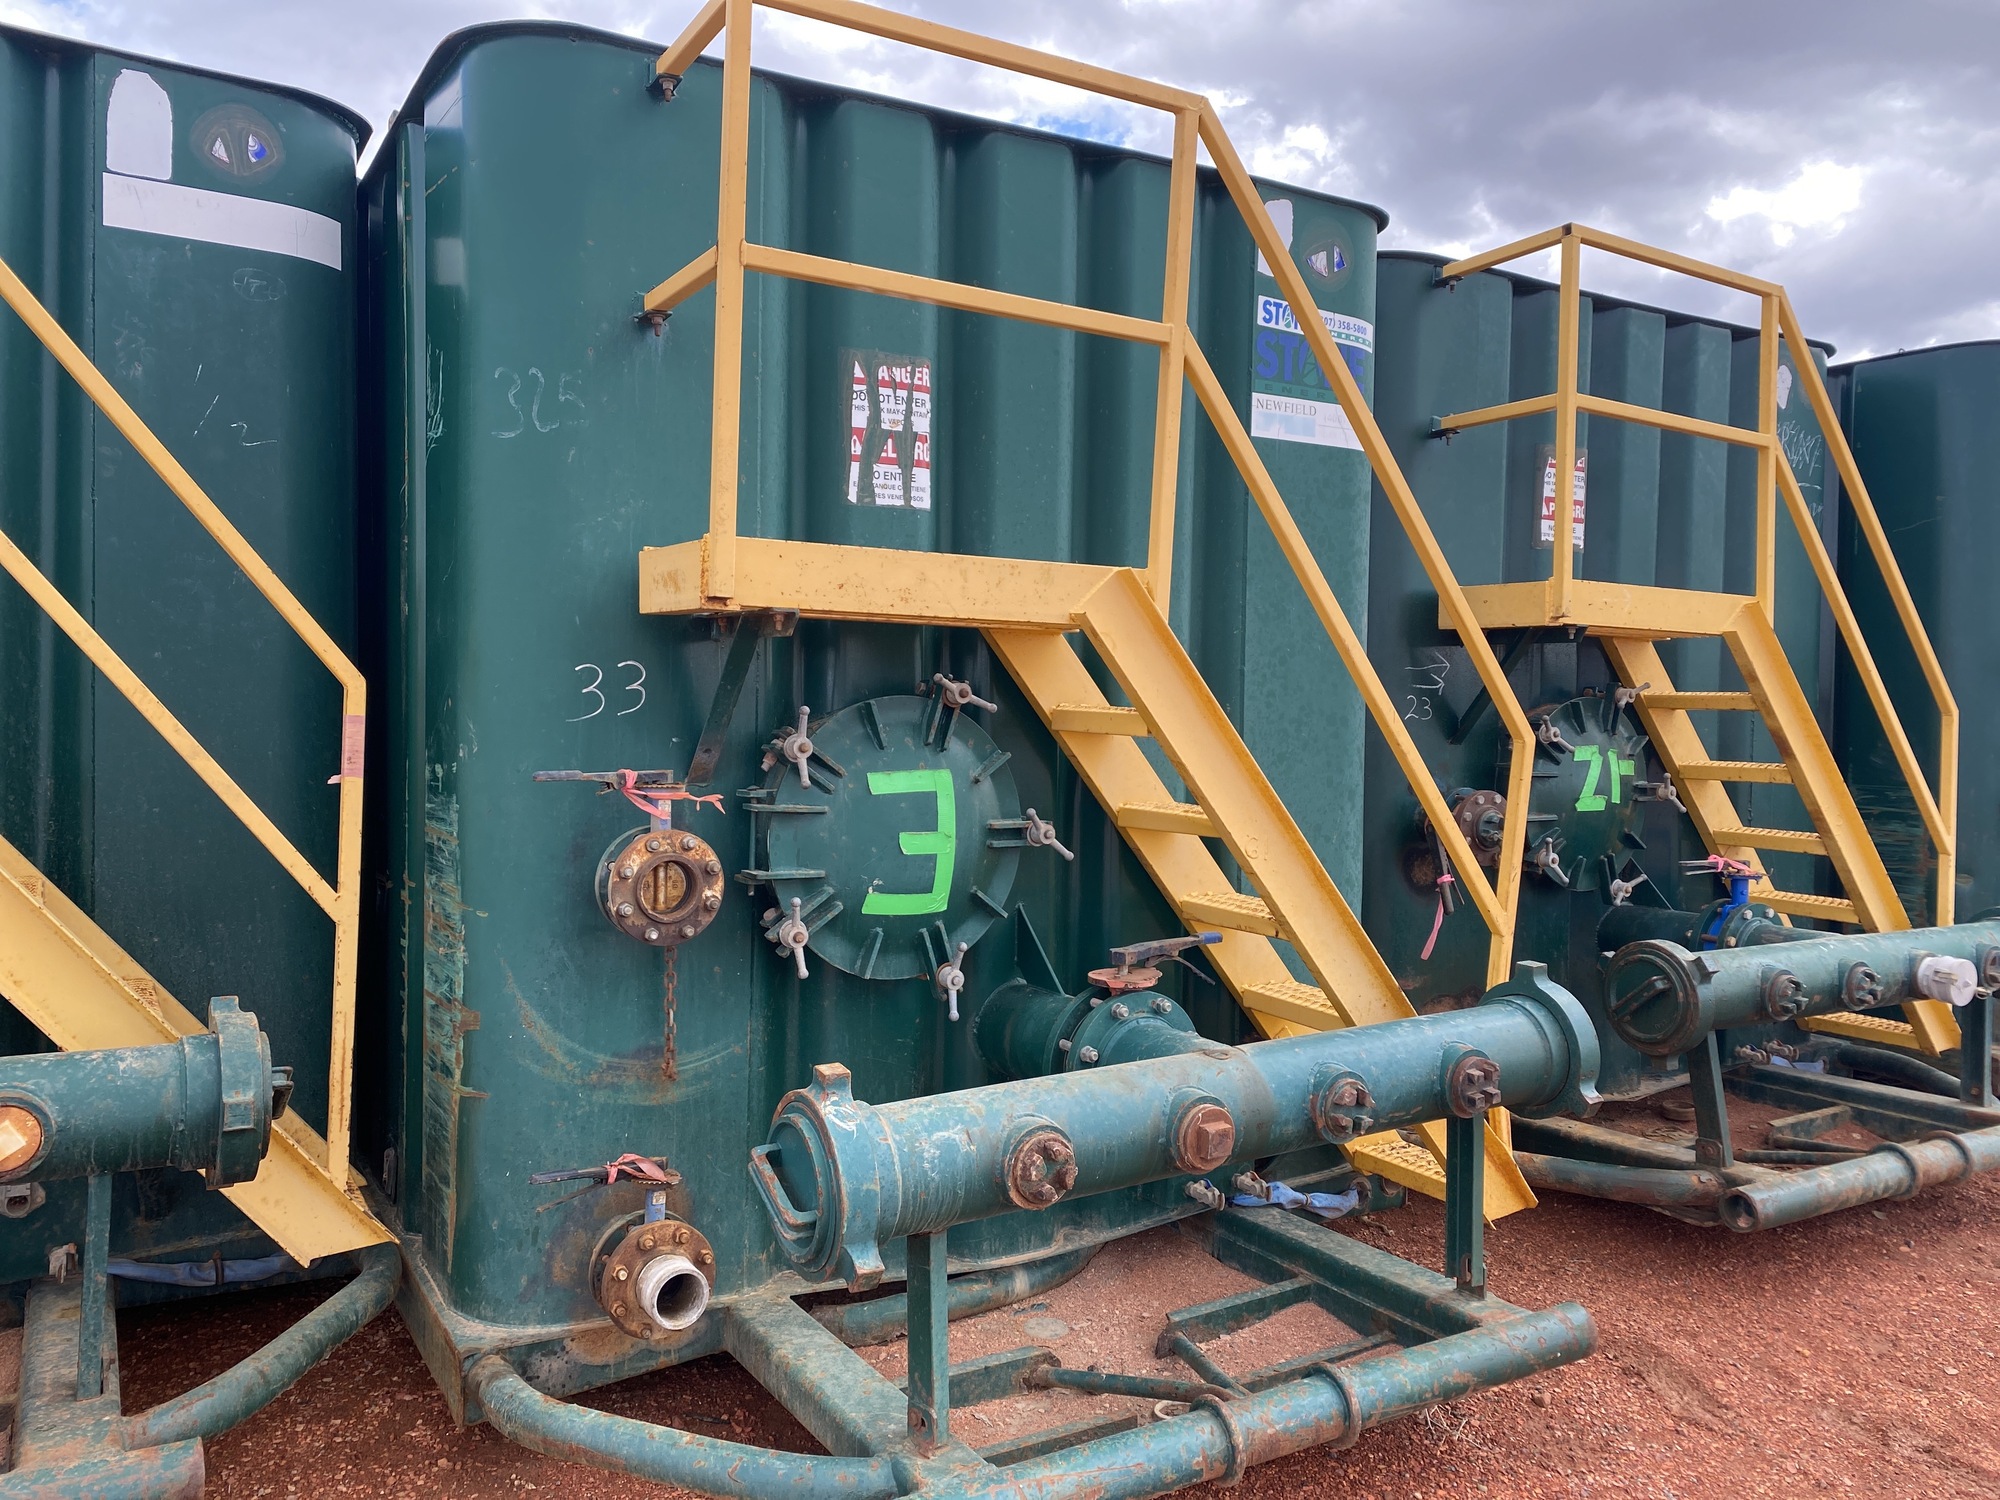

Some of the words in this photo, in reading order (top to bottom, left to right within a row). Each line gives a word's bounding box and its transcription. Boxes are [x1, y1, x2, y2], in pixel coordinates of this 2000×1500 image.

[1338, 320, 1367, 336] 358-5800
[1331, 332, 1369, 346] NERGY
[878, 365, 930, 387] ANGER
[1265, 383, 1326, 399] ENER
[879, 393, 892, 404] OT
[895, 395, 927, 409] ENER
[1256, 398, 1317, 416] NEWFIELD
[884, 471, 916, 483] ENTE
[565, 660, 647, 722] 33
[1404, 695, 1433, 721] 23
[860, 768, 957, 916] 3
